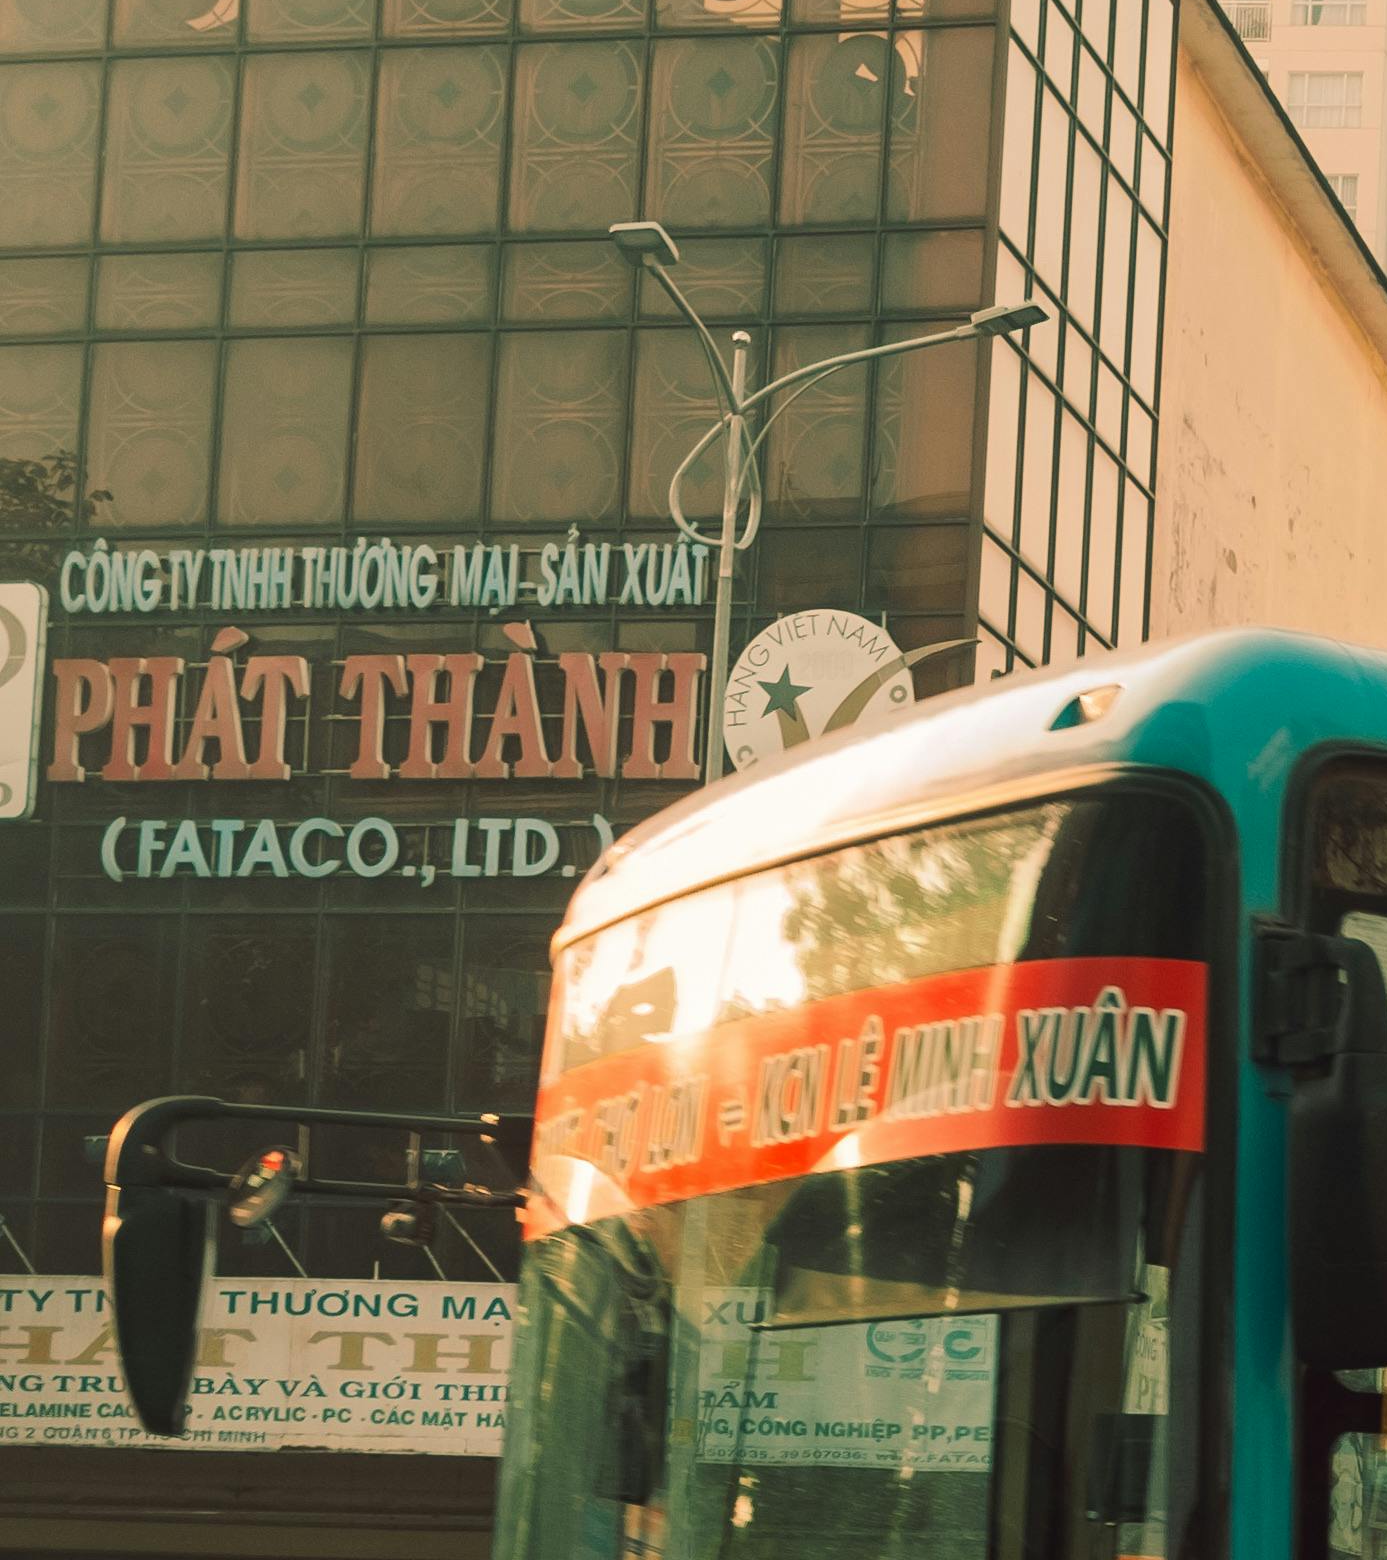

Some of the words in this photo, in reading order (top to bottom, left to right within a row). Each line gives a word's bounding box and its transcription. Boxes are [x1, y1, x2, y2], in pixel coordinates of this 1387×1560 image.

[61, 537, 162, 613] CÔNG
[169, 549, 205, 611] TY
[210, 547, 294, 610] TNHH
[301, 536, 439, 608] THƯƠNG
[618, 521, 710, 606] XUẤT
[826, 615, 890, 662] NAM
[46, 626, 311, 782] PHÁT
[340, 620, 708, 782] THÀNH
[829, 1015, 885, 1133] LÊ
[884, 1012, 1005, 1123] MINH
[1004, 986, 1187, 1109] XUÂN
[219, 1289, 420, 1318] THƯƠNG
[441, 1295, 512, 1327] MẠ
[0, 1403, 92, 1418] ELAMINE
[212, 1405, 306, 1423] ACRYLIC
[370, 1405, 416, 1426] CÁC
[275, 1374, 328, 1398] VÀ
[339, 1375, 423, 1400] GIỚI
[698, 1381, 779, 1409] HẨM
